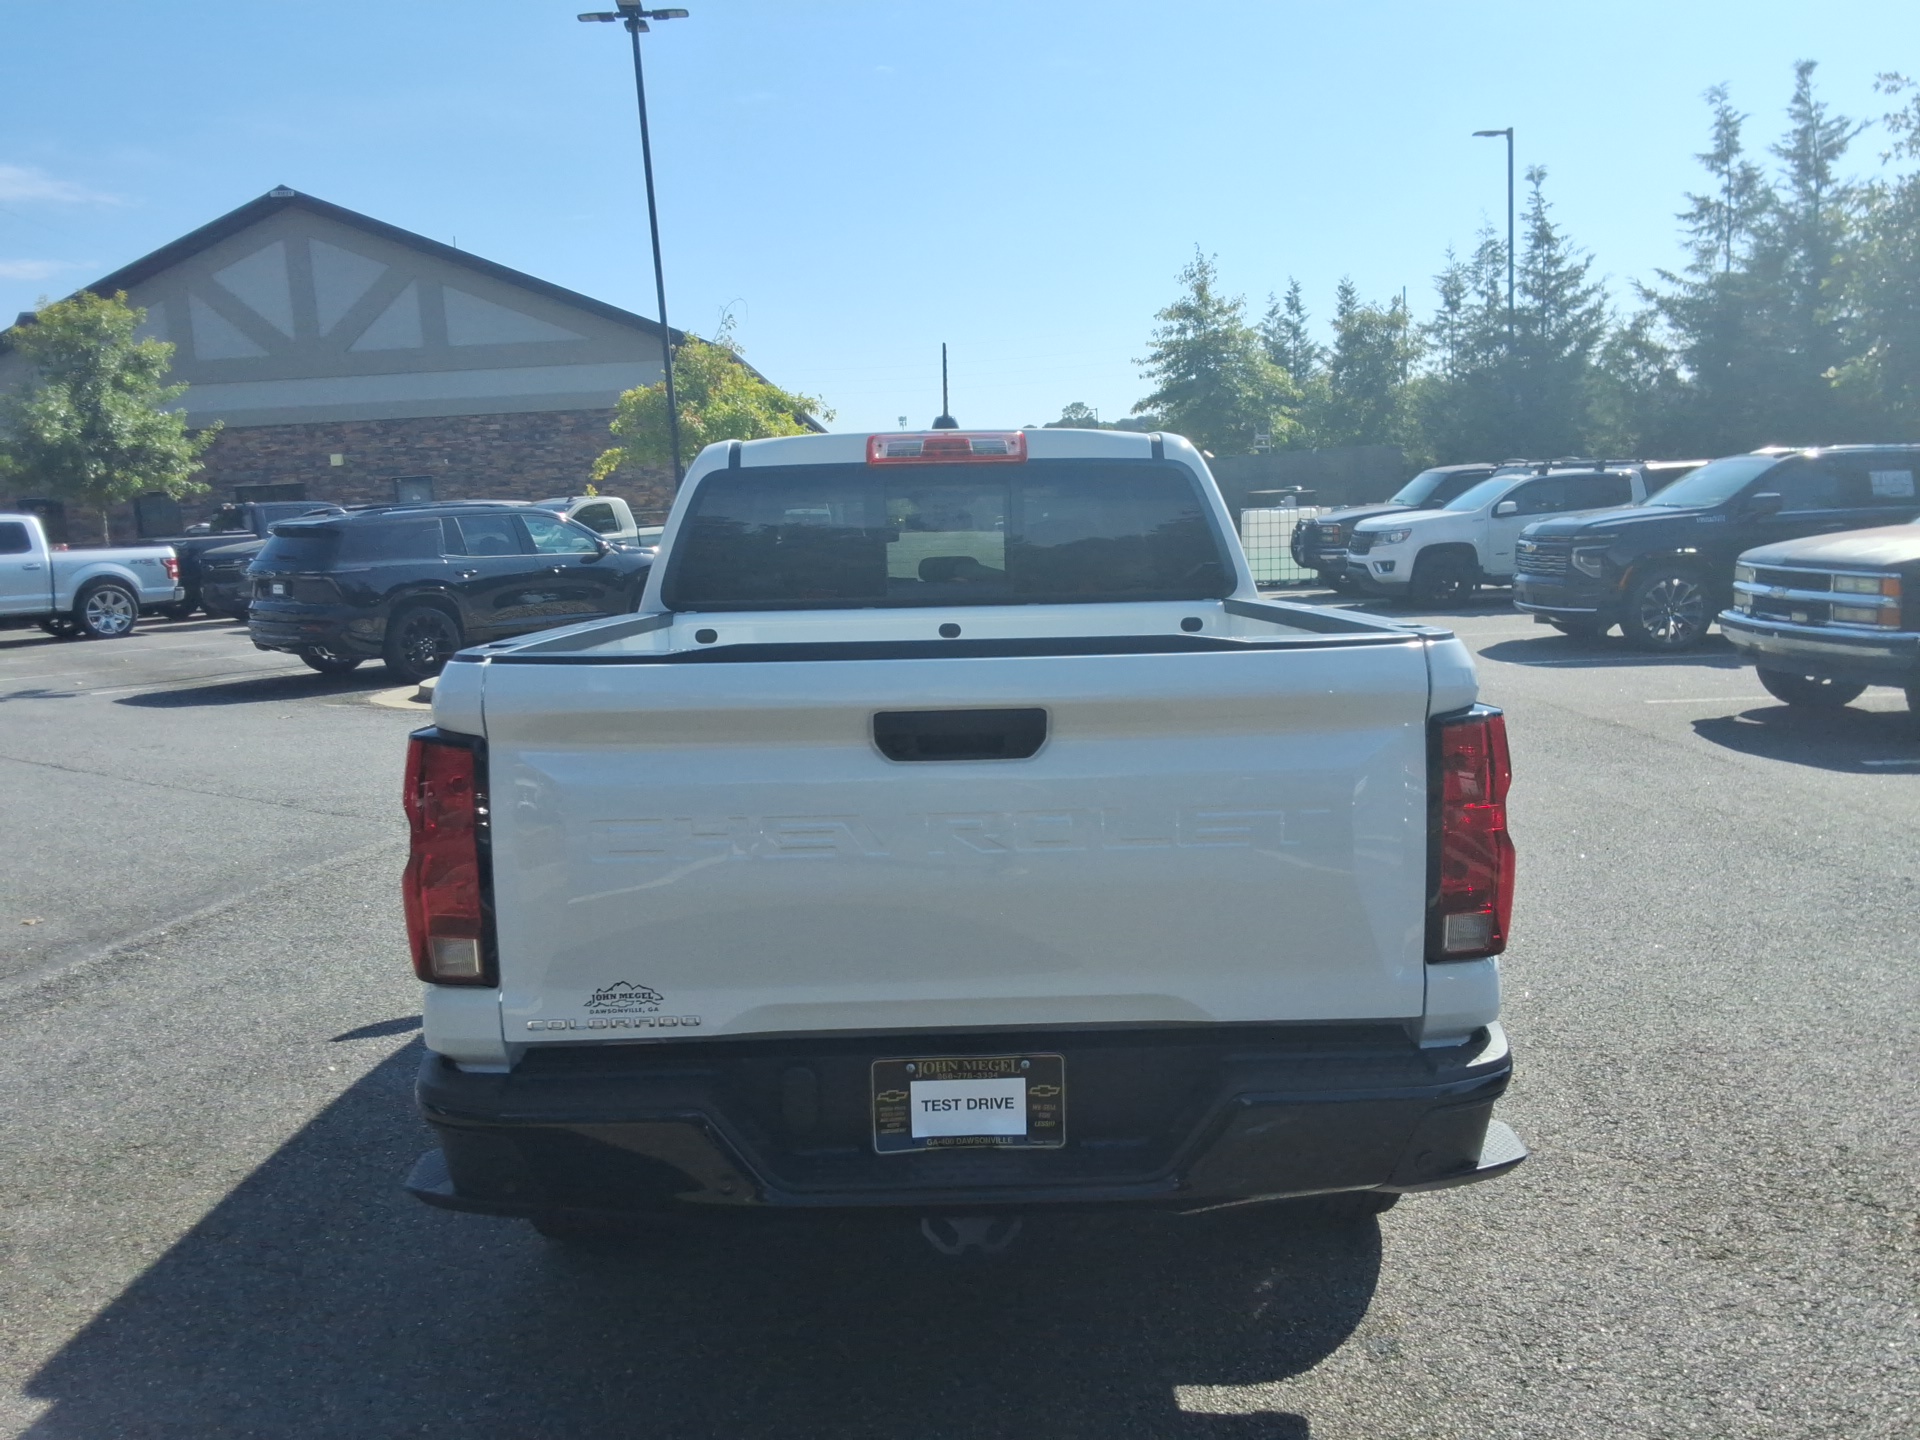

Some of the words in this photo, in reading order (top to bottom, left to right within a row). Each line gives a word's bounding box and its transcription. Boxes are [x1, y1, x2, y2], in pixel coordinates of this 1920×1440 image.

[589, 807, 1333, 863] CHEVROLET
[592, 993, 617, 1004] JOHN
[619, 992, 654, 1000] MEGEL
[526, 1014, 702, 1031] COLORADO
[915, 1060, 959, 1078] JOHN
[963, 1059, 1021, 1073] MEGEL
[921, 1098, 961, 1112] TEST
[967, 1097, 1014, 1110] DRIVE
[956, 1136, 1014, 1145] DAWSONVILLE
